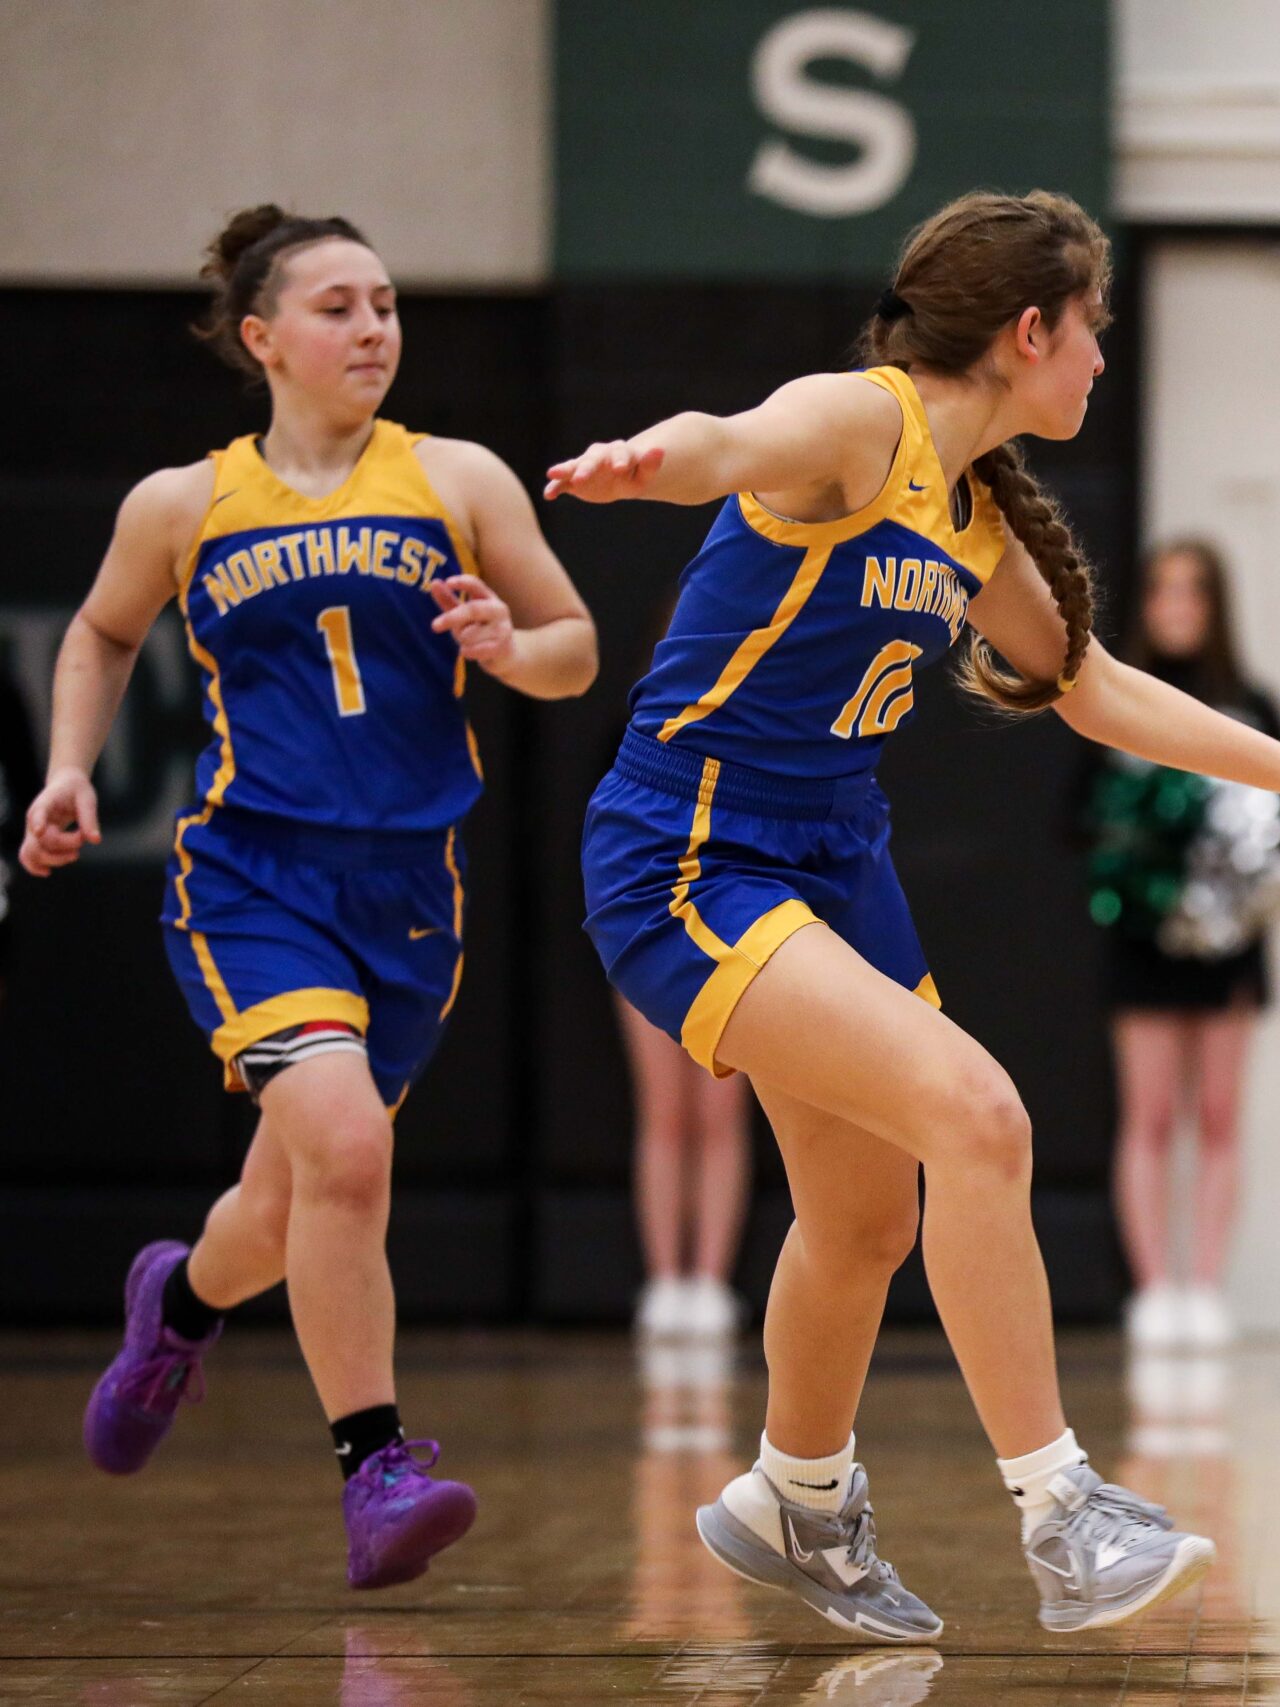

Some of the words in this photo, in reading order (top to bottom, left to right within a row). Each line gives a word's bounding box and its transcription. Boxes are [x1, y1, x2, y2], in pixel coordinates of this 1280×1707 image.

[747, 9, 917, 218] S
[202, 526, 448, 617] NORTHWEST
[316, 605, 367, 718] 1
[830, 639, 923, 740] 10
